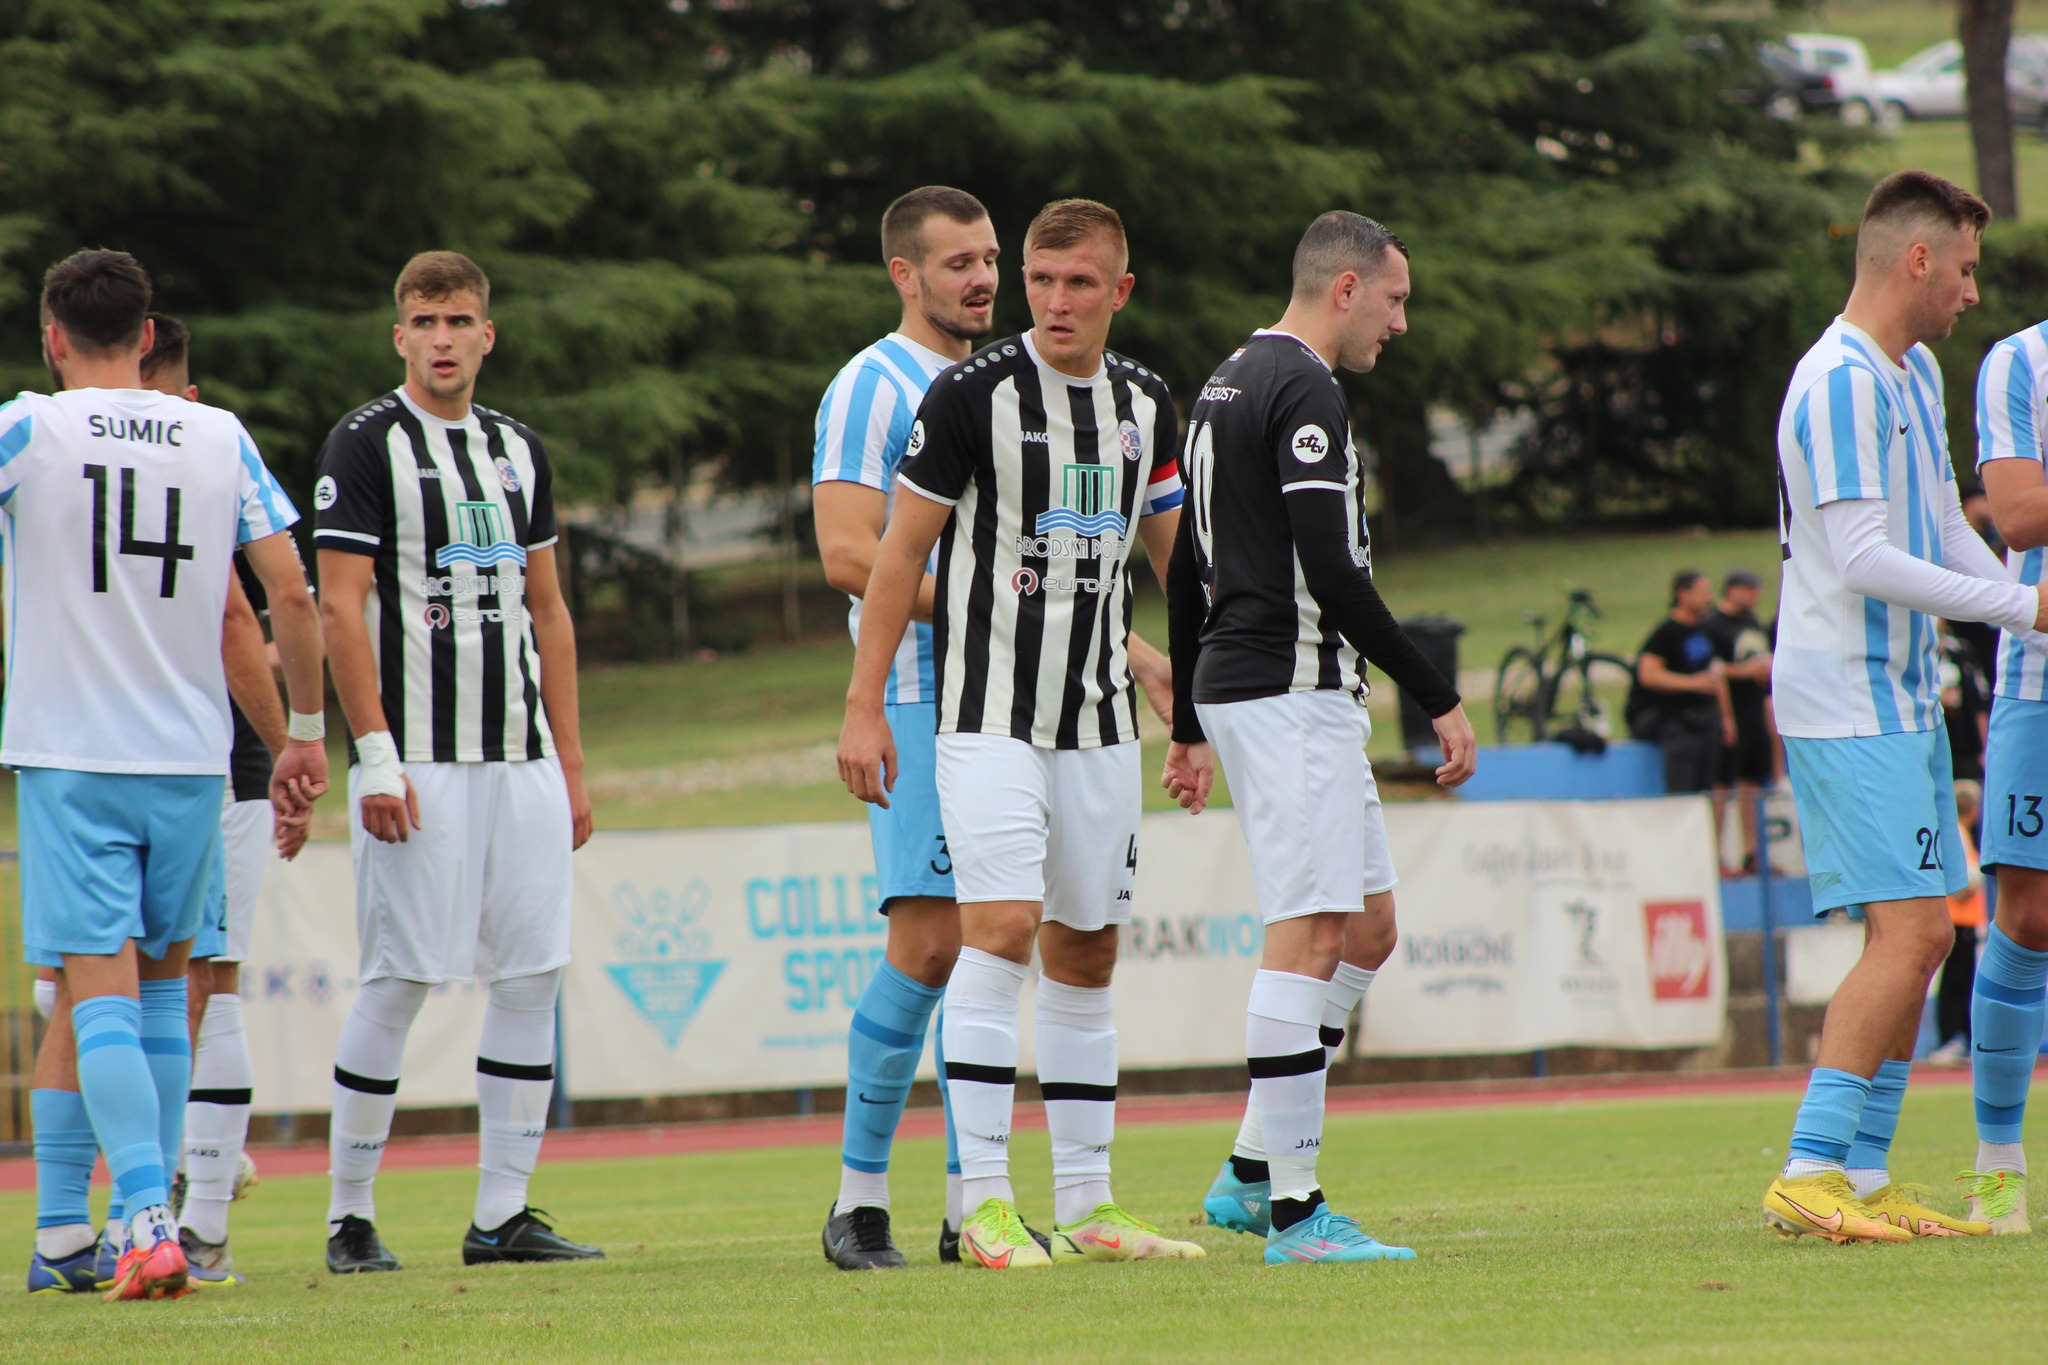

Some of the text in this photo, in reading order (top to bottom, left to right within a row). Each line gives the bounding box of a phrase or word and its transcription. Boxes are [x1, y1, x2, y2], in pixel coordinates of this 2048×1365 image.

[89, 414, 183, 447] SUMIĆ
[1020, 430, 1050, 443] JAKO
[83, 463, 194, 598] 14
[1016, 536, 1088, 559] BRODSKA
[2008, 794, 2044, 838] 13
[931, 835, 952, 875] 3
[1116, 890, 1132, 901] JA
